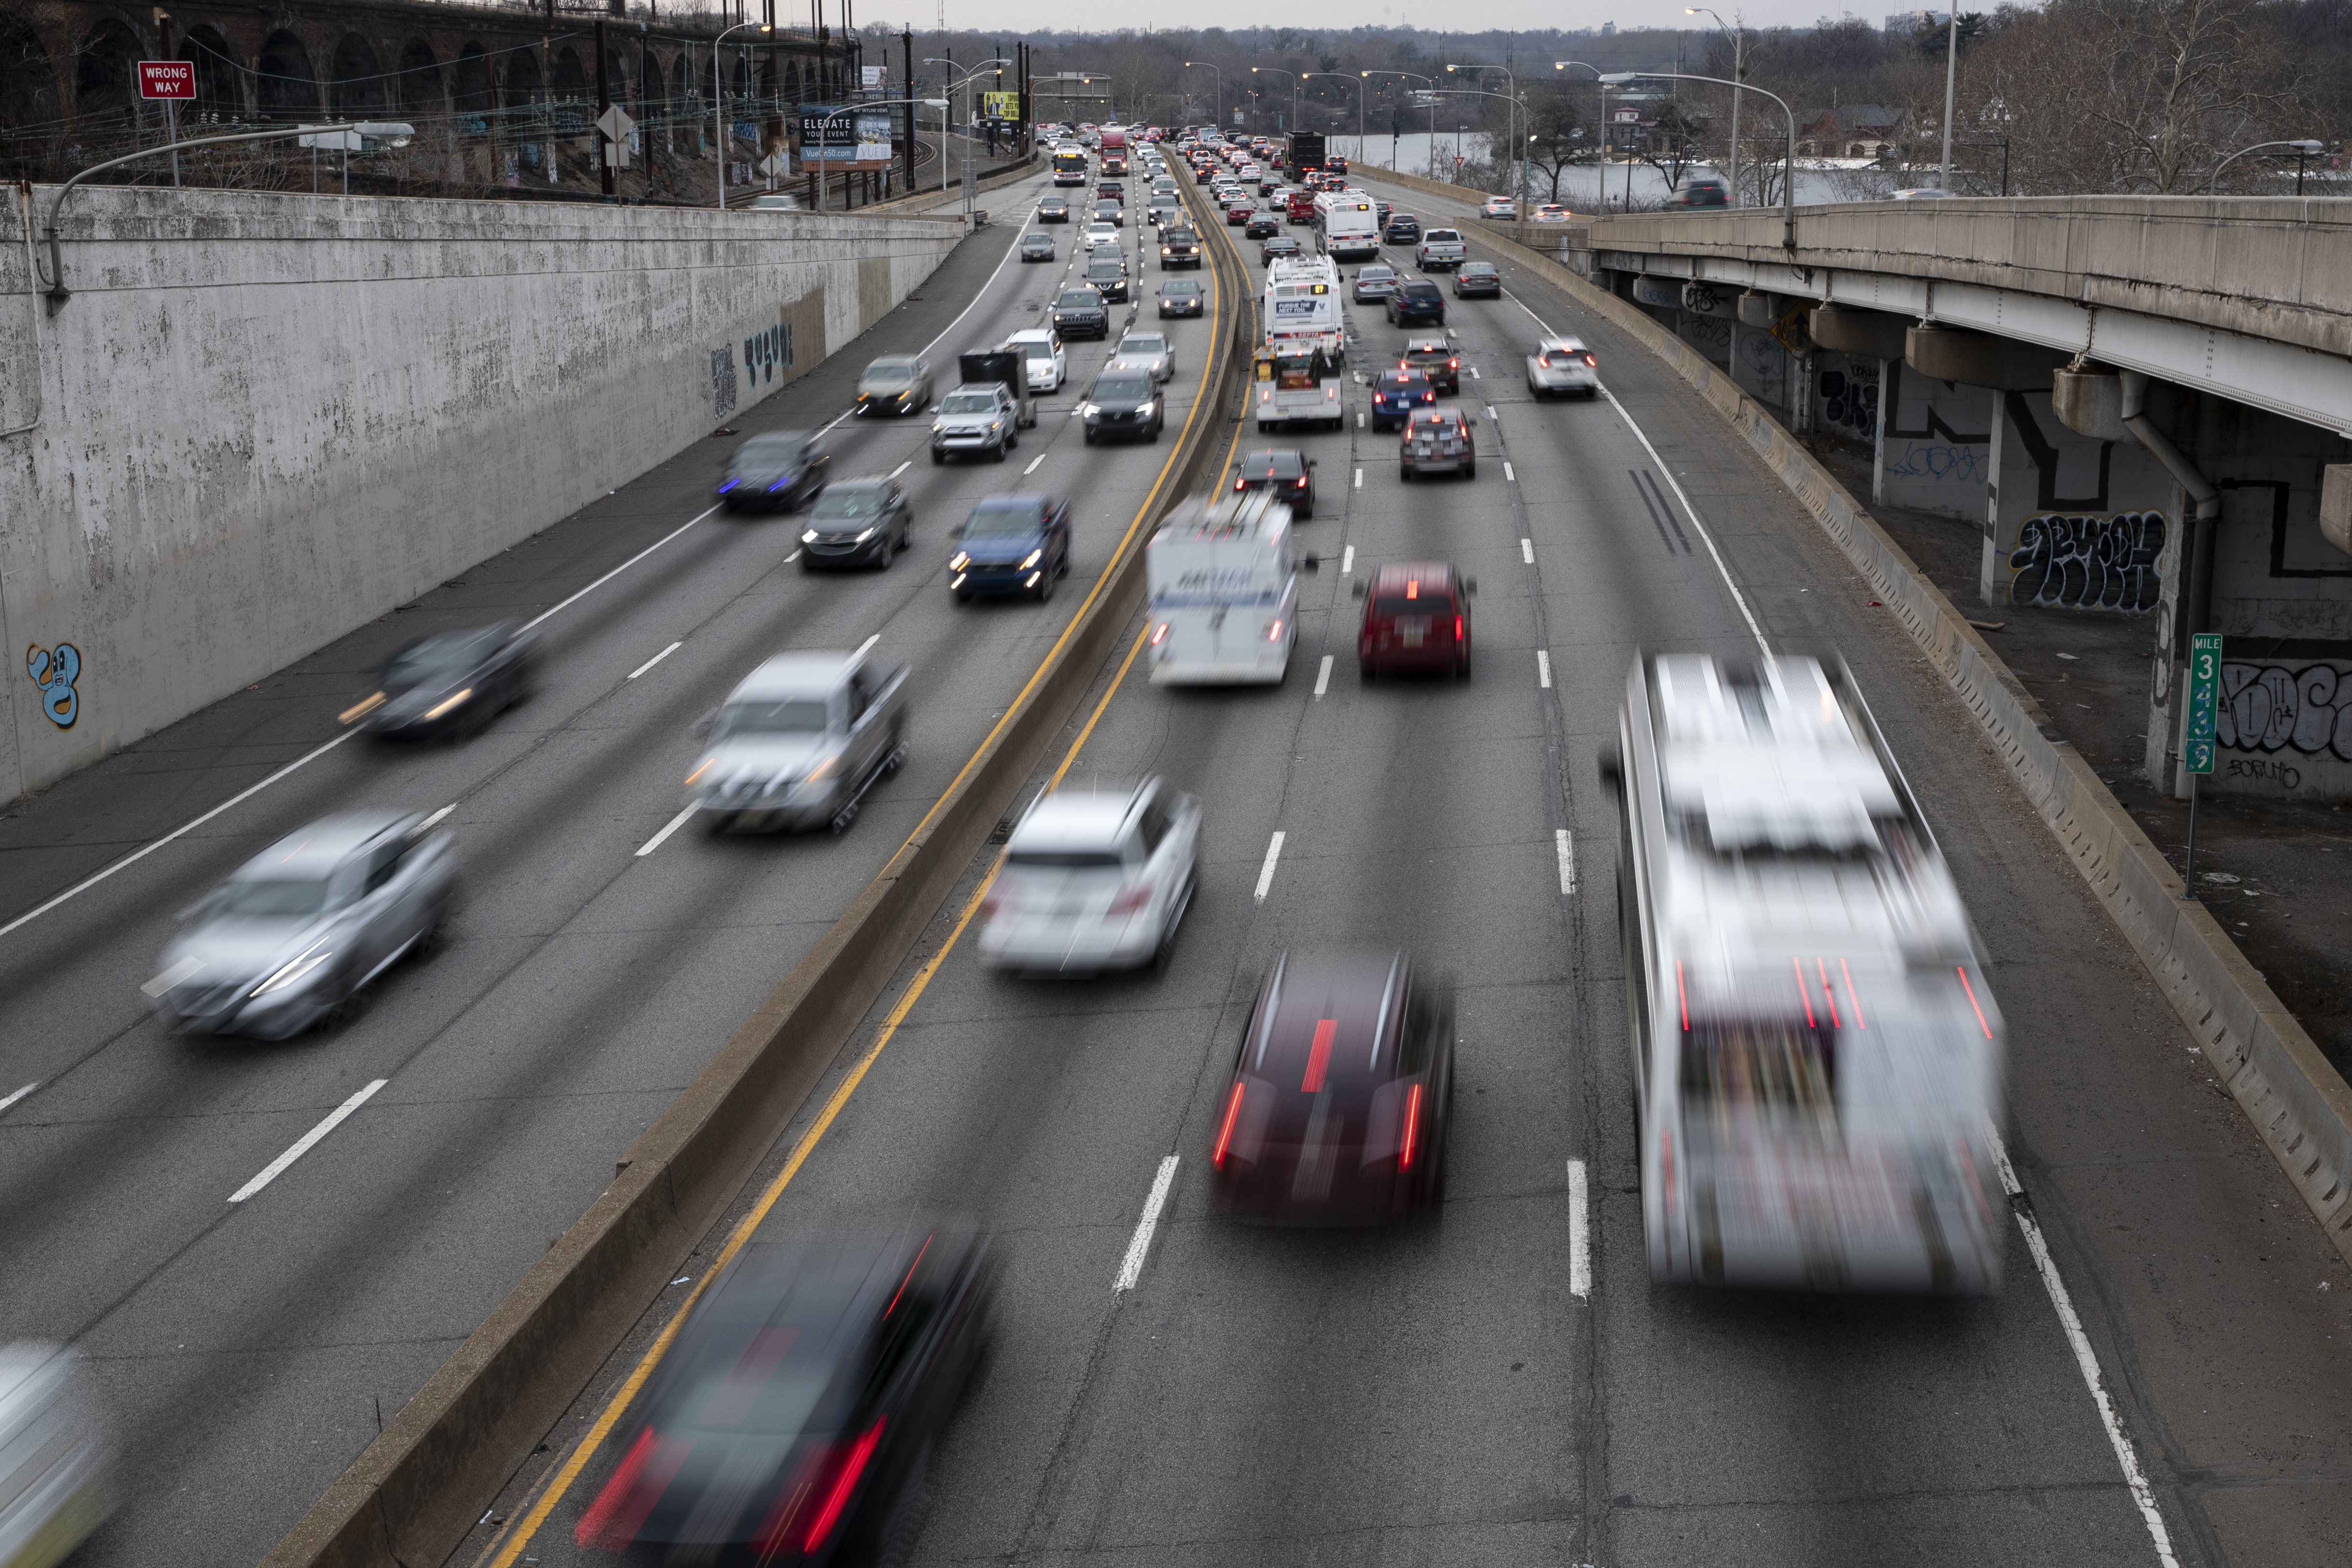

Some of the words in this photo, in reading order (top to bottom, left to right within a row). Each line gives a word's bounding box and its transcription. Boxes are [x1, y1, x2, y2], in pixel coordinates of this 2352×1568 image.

[146, 68, 187, 78] WRONG
[155, 82, 180, 92] WAY
[805, 119, 851, 128] ELEVATE
[861, 145, 879, 157] VUE
[1315, 285, 1324, 293] 27
[2195, 638, 2220, 649] MILE
